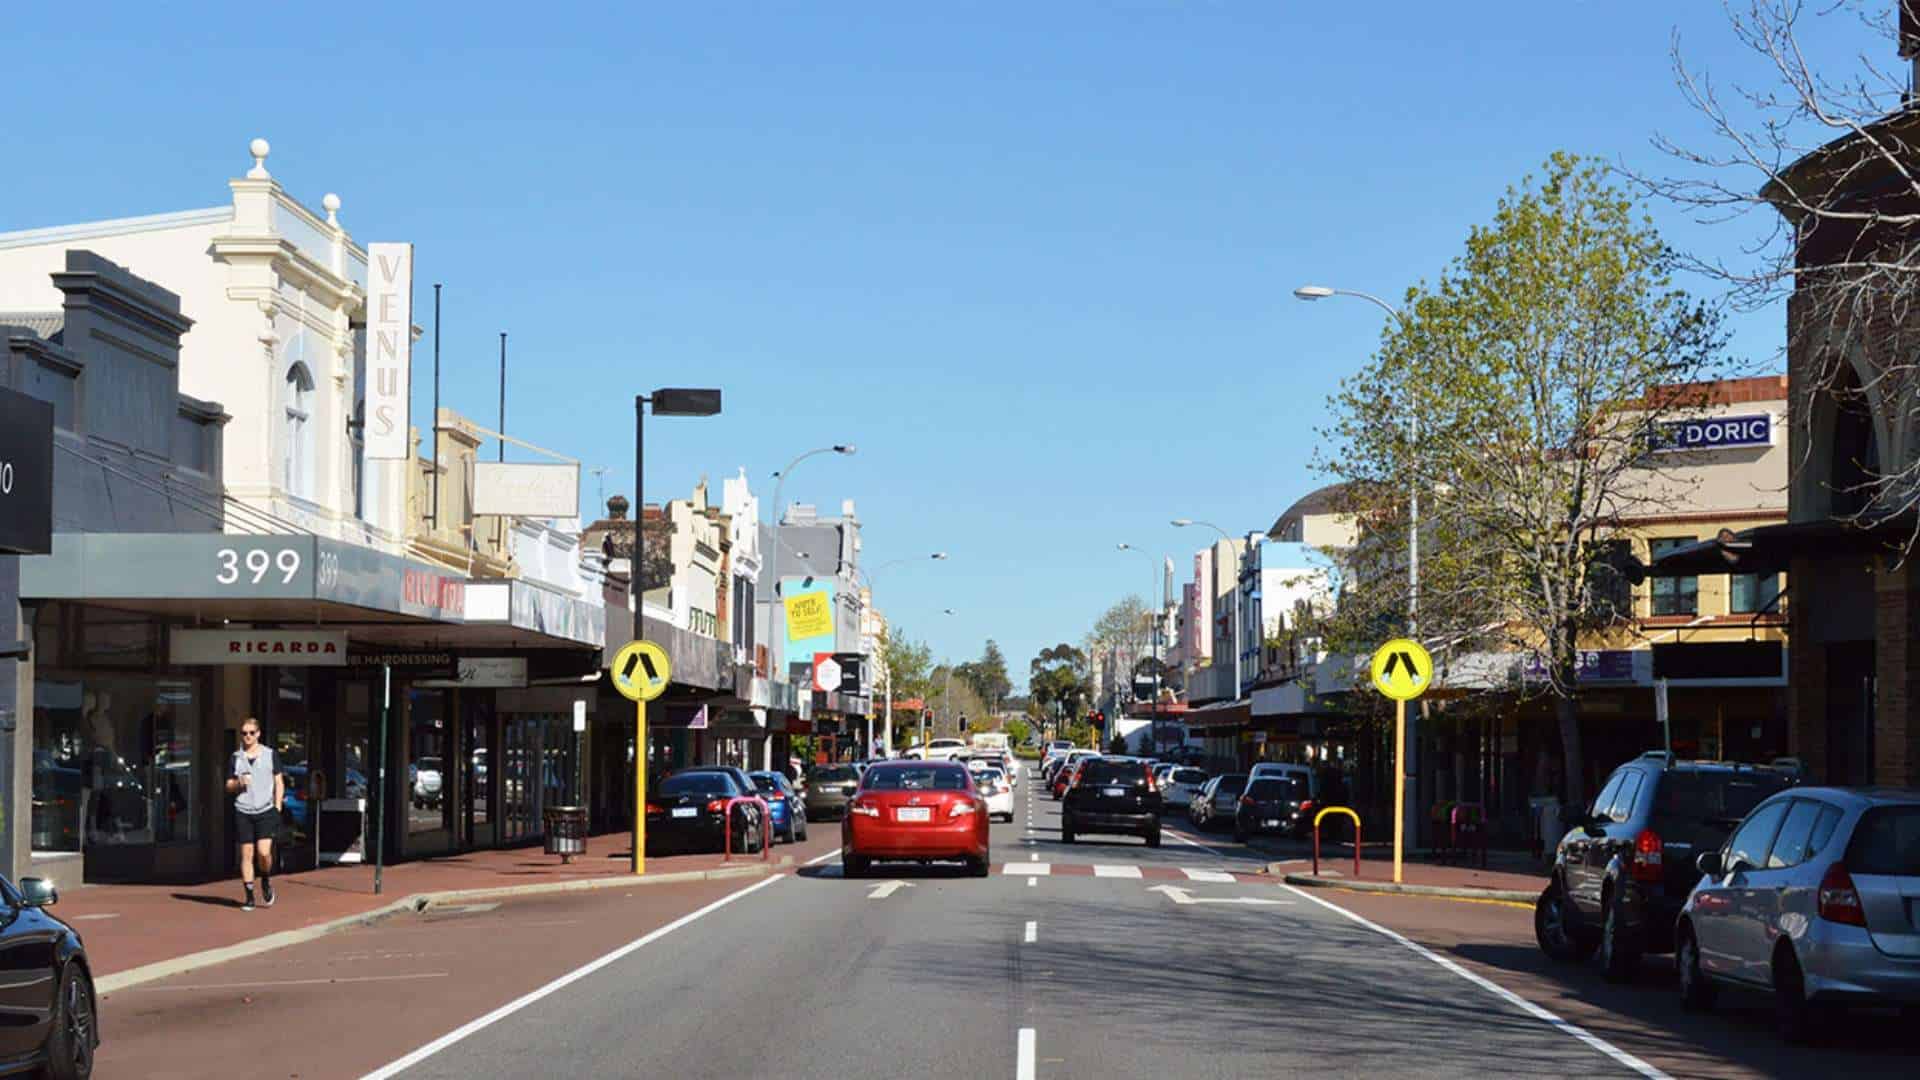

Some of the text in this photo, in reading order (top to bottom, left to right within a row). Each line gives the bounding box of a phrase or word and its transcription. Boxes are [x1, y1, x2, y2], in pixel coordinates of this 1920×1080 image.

[376, 255, 401, 437] VENUS
[1686, 420, 1766, 443] DORIC
[216, 548, 300, 585] 399
[319, 551, 338, 587] 399
[229, 640, 337, 654] RICARDA
[365, 655, 450, 665] HAIRDRESSING
